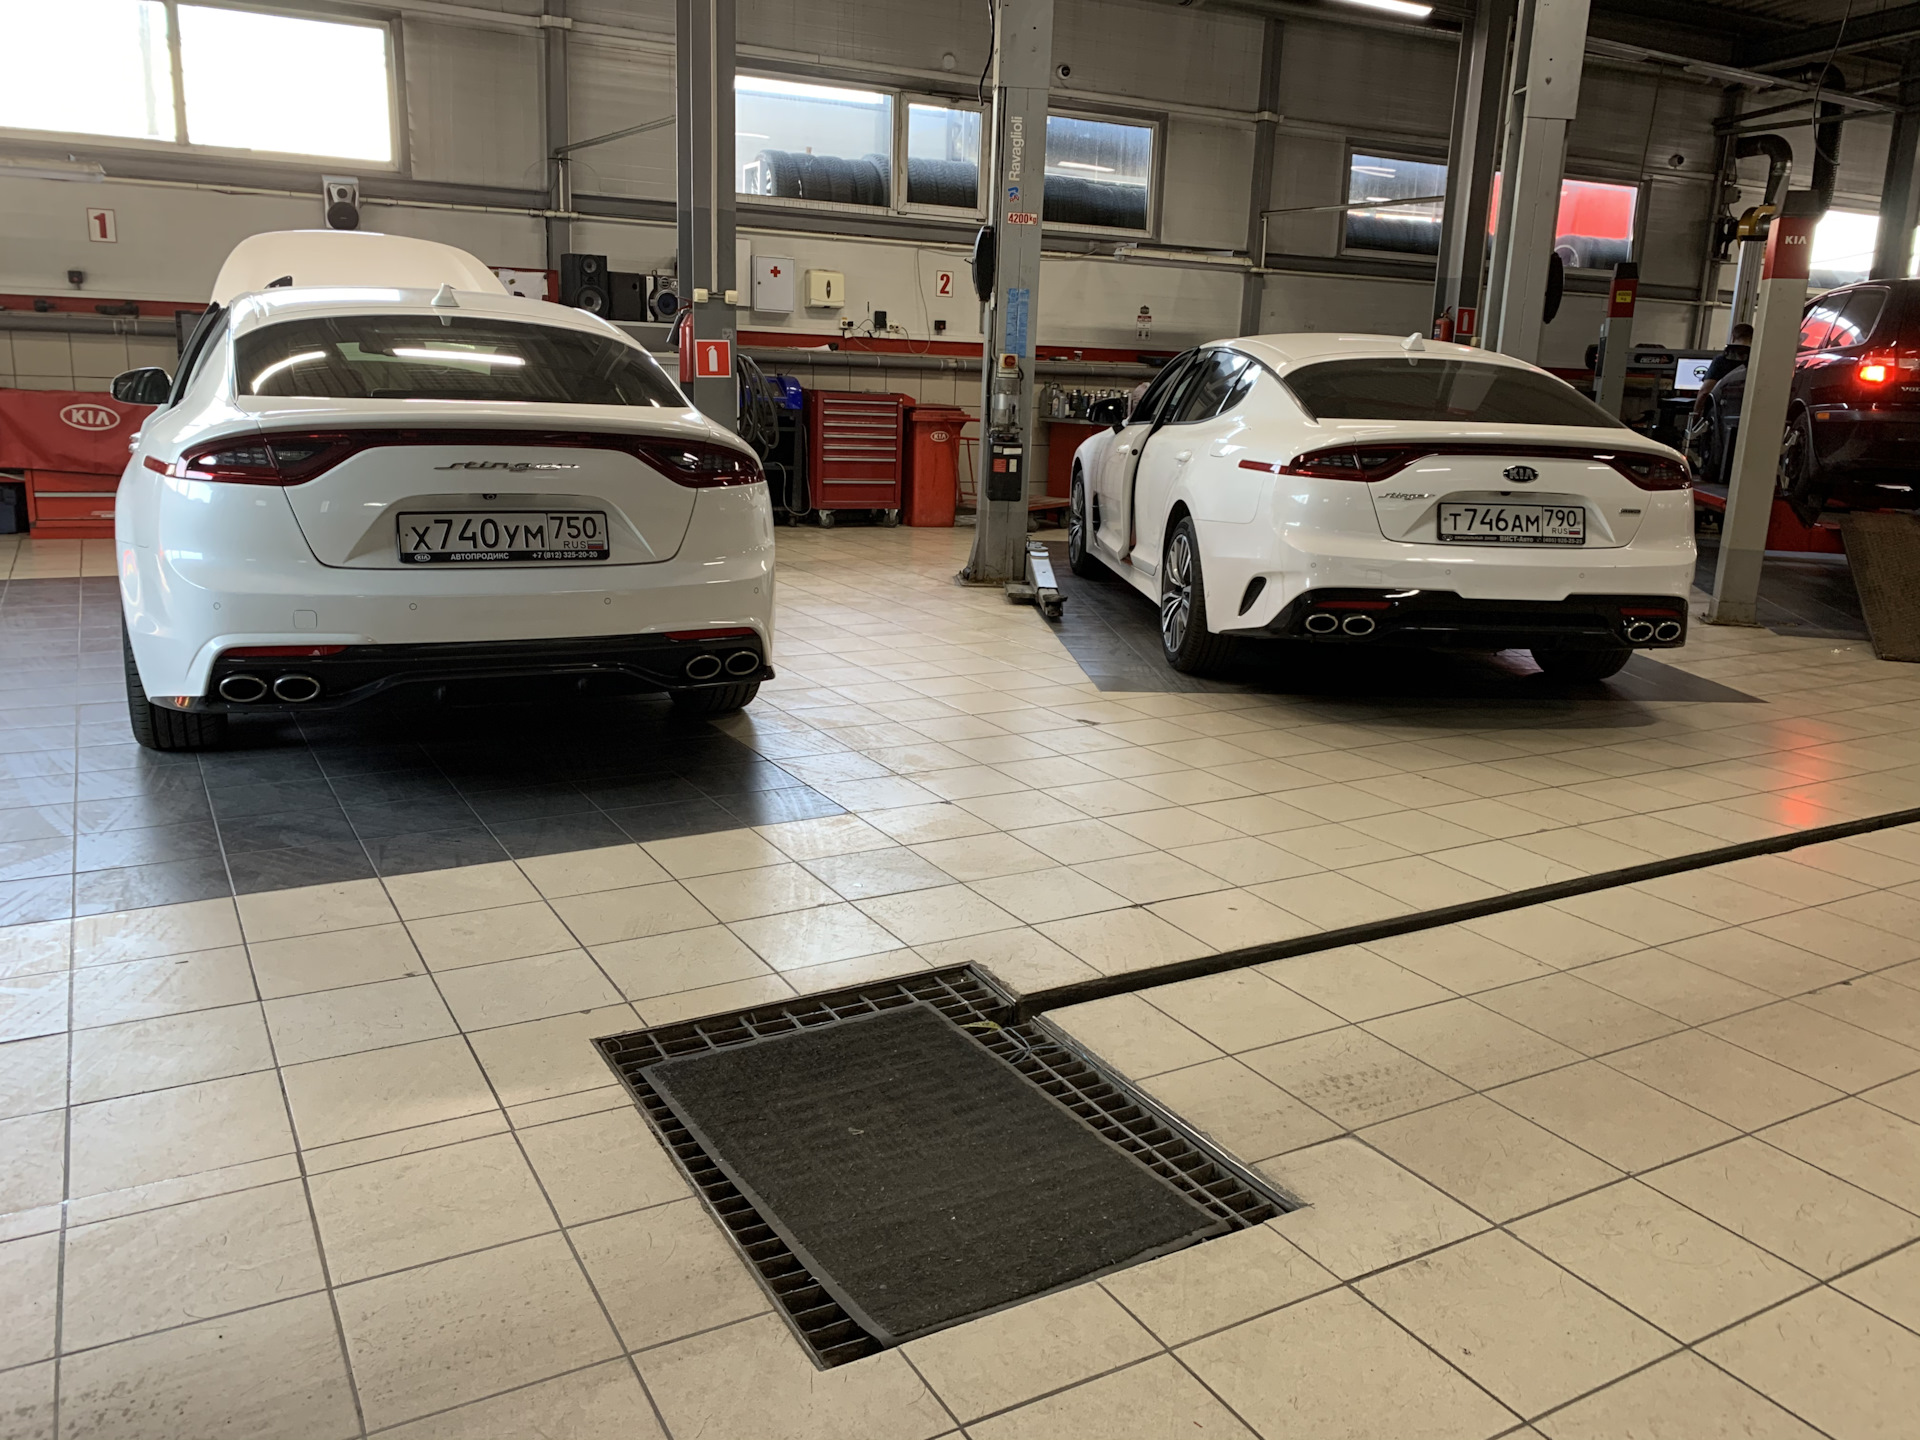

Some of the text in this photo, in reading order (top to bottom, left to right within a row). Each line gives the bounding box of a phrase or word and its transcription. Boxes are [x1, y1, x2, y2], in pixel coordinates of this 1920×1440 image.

[1008, 115, 1025, 182] Ravaglioli
[93, 212, 108, 239] 1
[1784, 235, 1807, 245] KIA
[939, 273, 951, 295] 2
[71, 408, 110, 426] KIA
[1508, 467, 1535, 480] KIA
[1544, 509, 1577, 527] 790
[550, 516, 597, 540] 750
[1551, 527, 1568, 535] RUS
[563, 540, 587, 549] RUS
[450, 552, 510, 561] АВТОПРОДИКС
[543, 551, 562, 560] (812)
